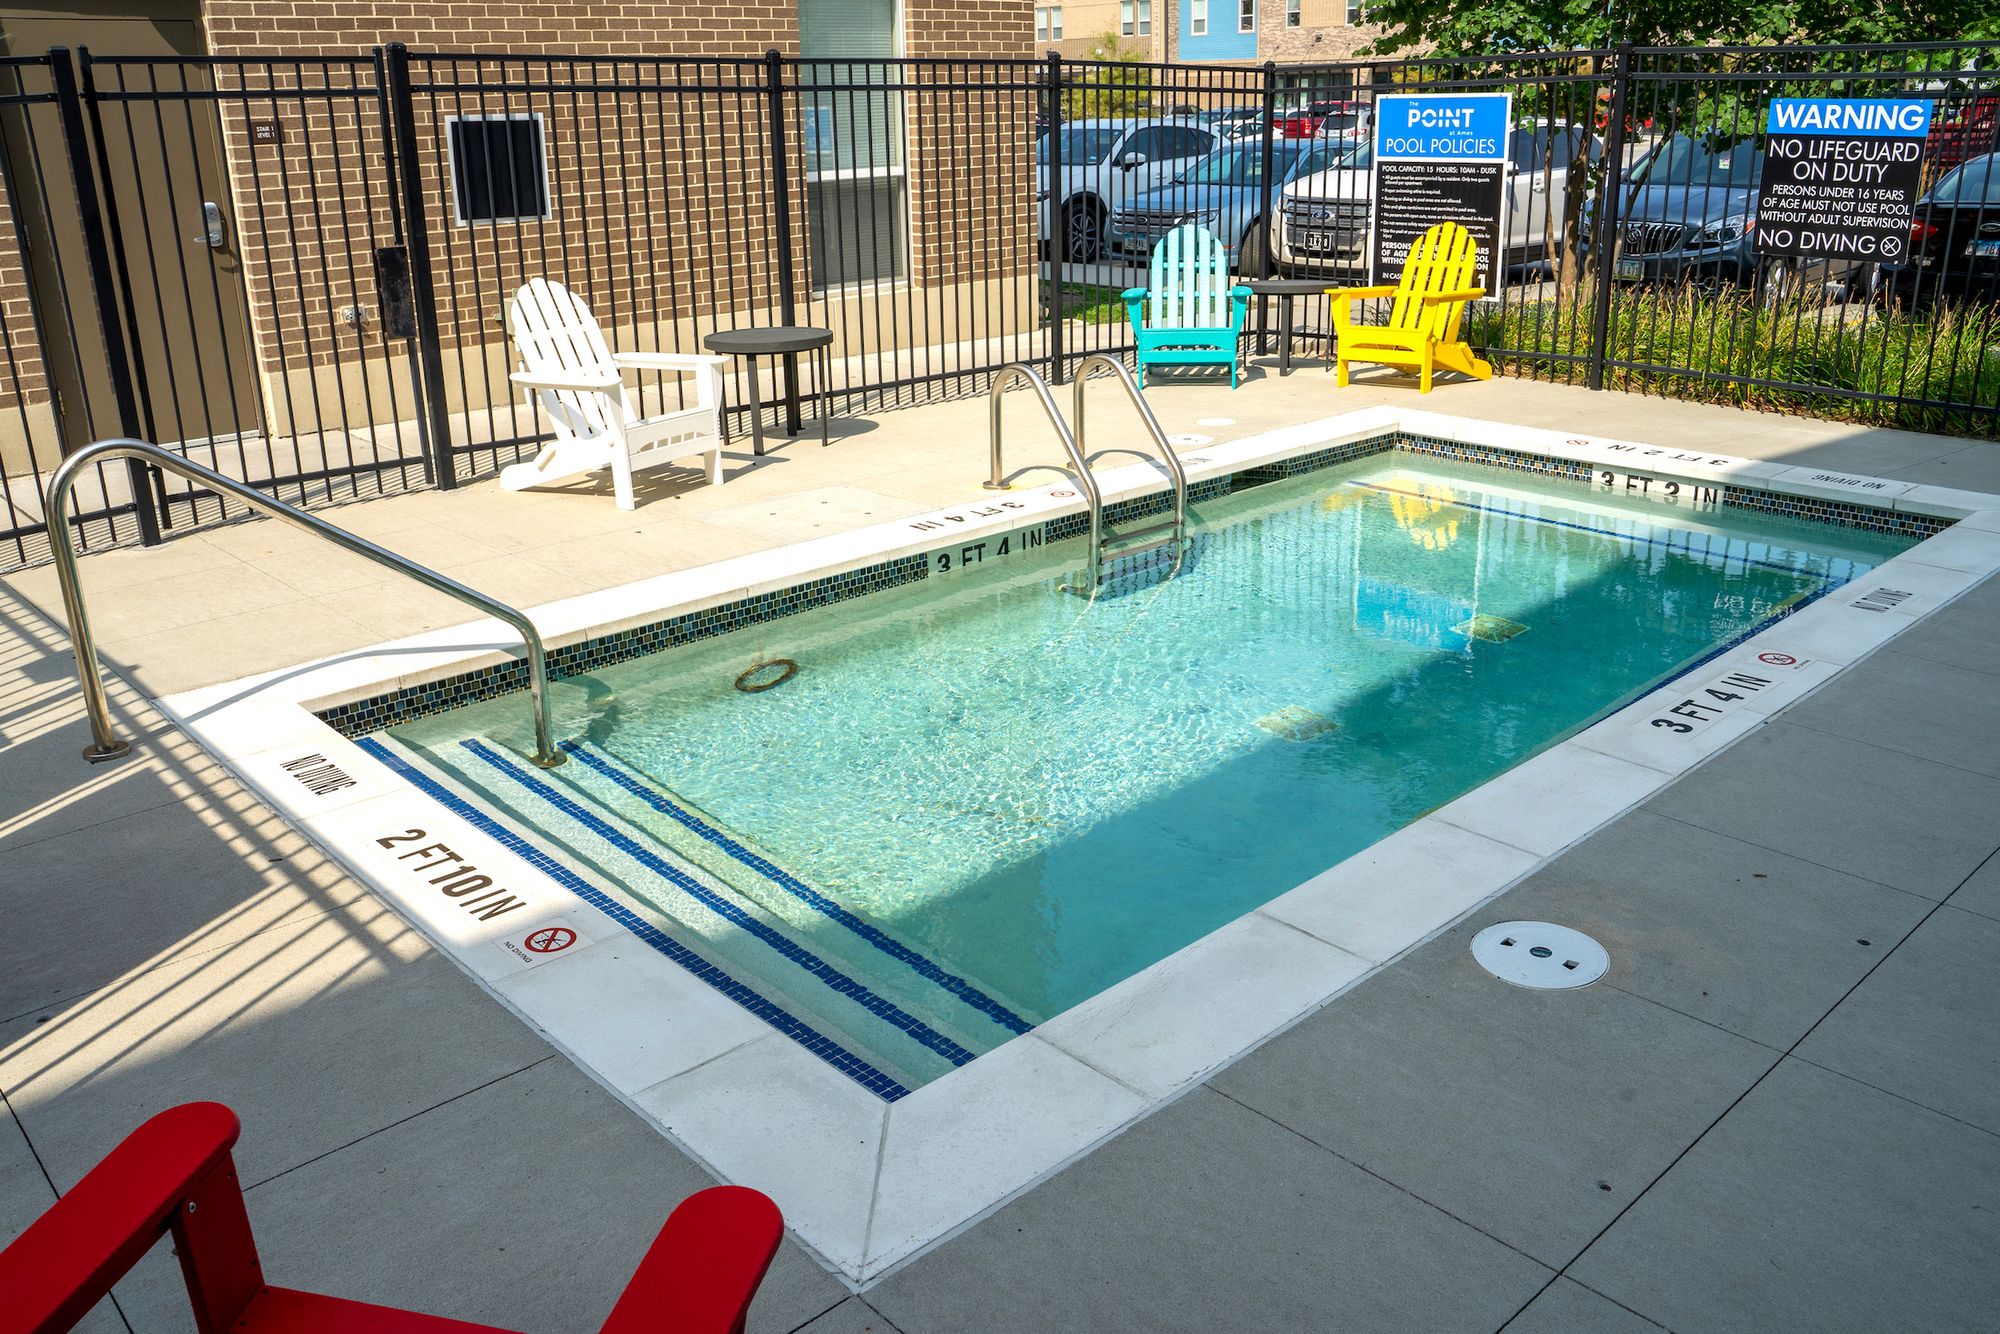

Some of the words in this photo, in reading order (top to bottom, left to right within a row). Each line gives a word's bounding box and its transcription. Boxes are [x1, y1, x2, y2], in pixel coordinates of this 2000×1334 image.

[1408, 108, 1475, 128] POINT
[1775, 103, 1925, 131] WARNING
[1386, 138, 1426, 153] POOL
[1430, 138, 1496, 154] POLICIES
[1769, 139, 1803, 159] NO
[1808, 140, 1920, 162] LIFEGUARD
[1436, 166, 1459, 174] HOURS:
[1460, 166, 1476, 174] 10AM
[1793, 161, 1827, 181] ON
[1833, 162, 1889, 183] DUTY
[1772, 184, 1817, 197] PERSONS
[1819, 186, 1854, 199] UNDER
[1858, 188, 1870, 200] 16
[1873, 189, 1904, 201] YEARS
[1762, 197, 1778, 208] OF
[1779, 198, 1800, 209] AGE
[1801, 200, 1830, 212] MUST
[1832, 201, 1855, 213] NOT
[1857, 203, 1877, 214] USE
[1879, 204, 1911, 216] POOL
[1759, 210, 1807, 223] WITHOUT
[1807, 213, 1841, 225] ADULT
[1843, 216, 1909, 229] SUPERVISION
[1382, 242, 1412, 250] PERSONS
[1758, 228, 1793, 248] NO
[1800, 232, 1876, 254] DIVING
[1382, 257, 1406, 265] WITHO
[1607, 444, 1637, 452] IN
[1667, 454, 1703, 462] FT
[1626, 474, 1653, 493] FT
[1693, 486, 1718, 505] IN
[1811, 475, 1861, 486] DIVING
[944, 515, 966, 523] 4
[970, 506, 1004, 518] FT
[909, 520, 945, 532] IN
[937, 553, 951, 573] 3
[961, 543, 986, 567] FT
[997, 536, 1011, 556] 4
[1022, 528, 1042, 550] IN
[1721, 673, 1772, 691] IN
[1705, 688, 1745, 702] 4
[1670, 699, 1724, 722] FT
[1651, 718, 1693, 733] 3
[280, 753, 327, 771] NO
[376, 828, 427, 850] 2
[504, 941, 515, 950] NO
[512, 948, 533, 964] DIVING
